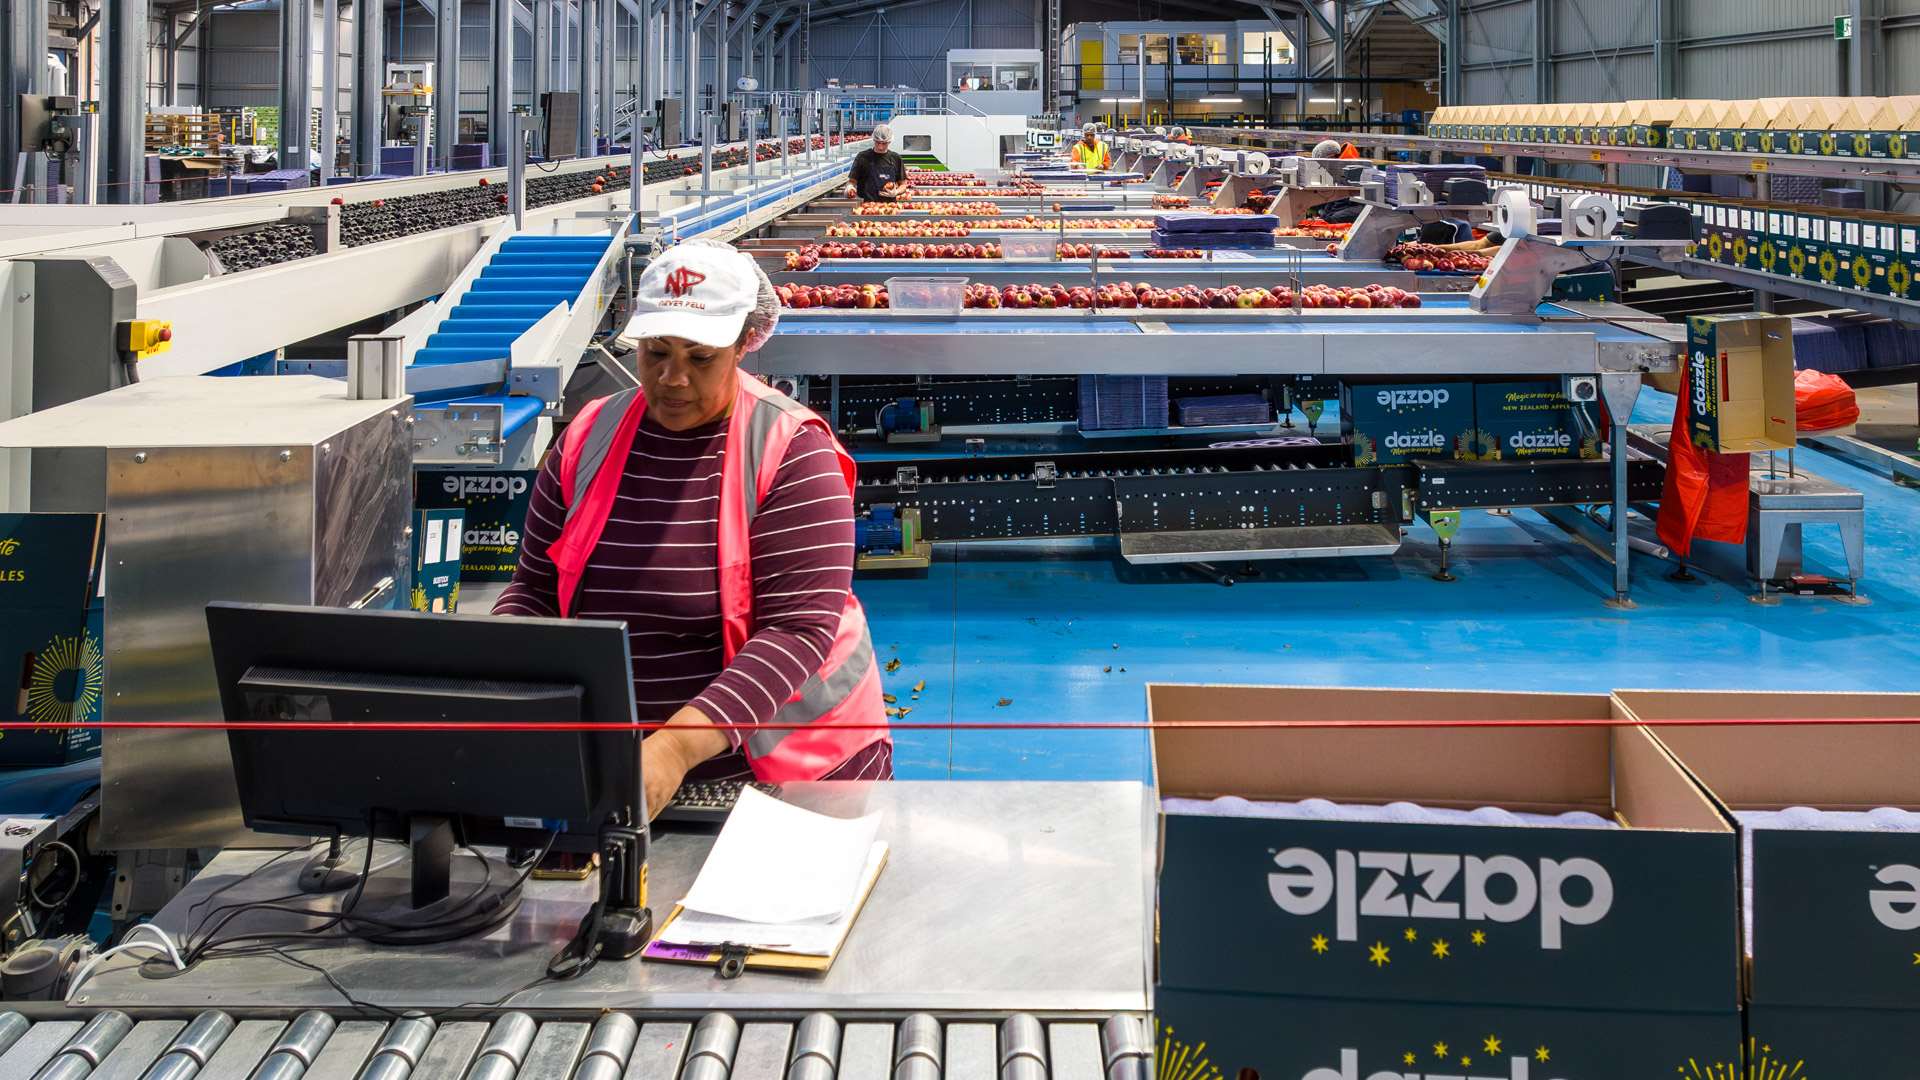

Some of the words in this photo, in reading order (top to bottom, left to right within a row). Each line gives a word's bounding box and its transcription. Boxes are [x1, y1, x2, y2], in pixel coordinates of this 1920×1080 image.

[664, 266, 706, 297] NP
[1692, 351, 1706, 416] dazzle
[1377, 389, 1449, 410] dazzle
[1505, 392, 1530, 402] Magic
[1537, 393, 1555, 401] every
[1555, 391, 1567, 399] bi
[1385, 430, 1445, 448] dazzle
[1510, 430, 1571, 448] dazzle
[1391, 447, 1410, 455] Magic
[1516, 447, 1535, 455] Magic
[443, 476, 527, 499] dazzle
[464, 525, 519, 545] azzle
[0, 538, 20, 556] te
[485, 546, 502, 555] every
[0, 570, 24, 581] LES
[1268, 847, 1614, 949] dazzle
